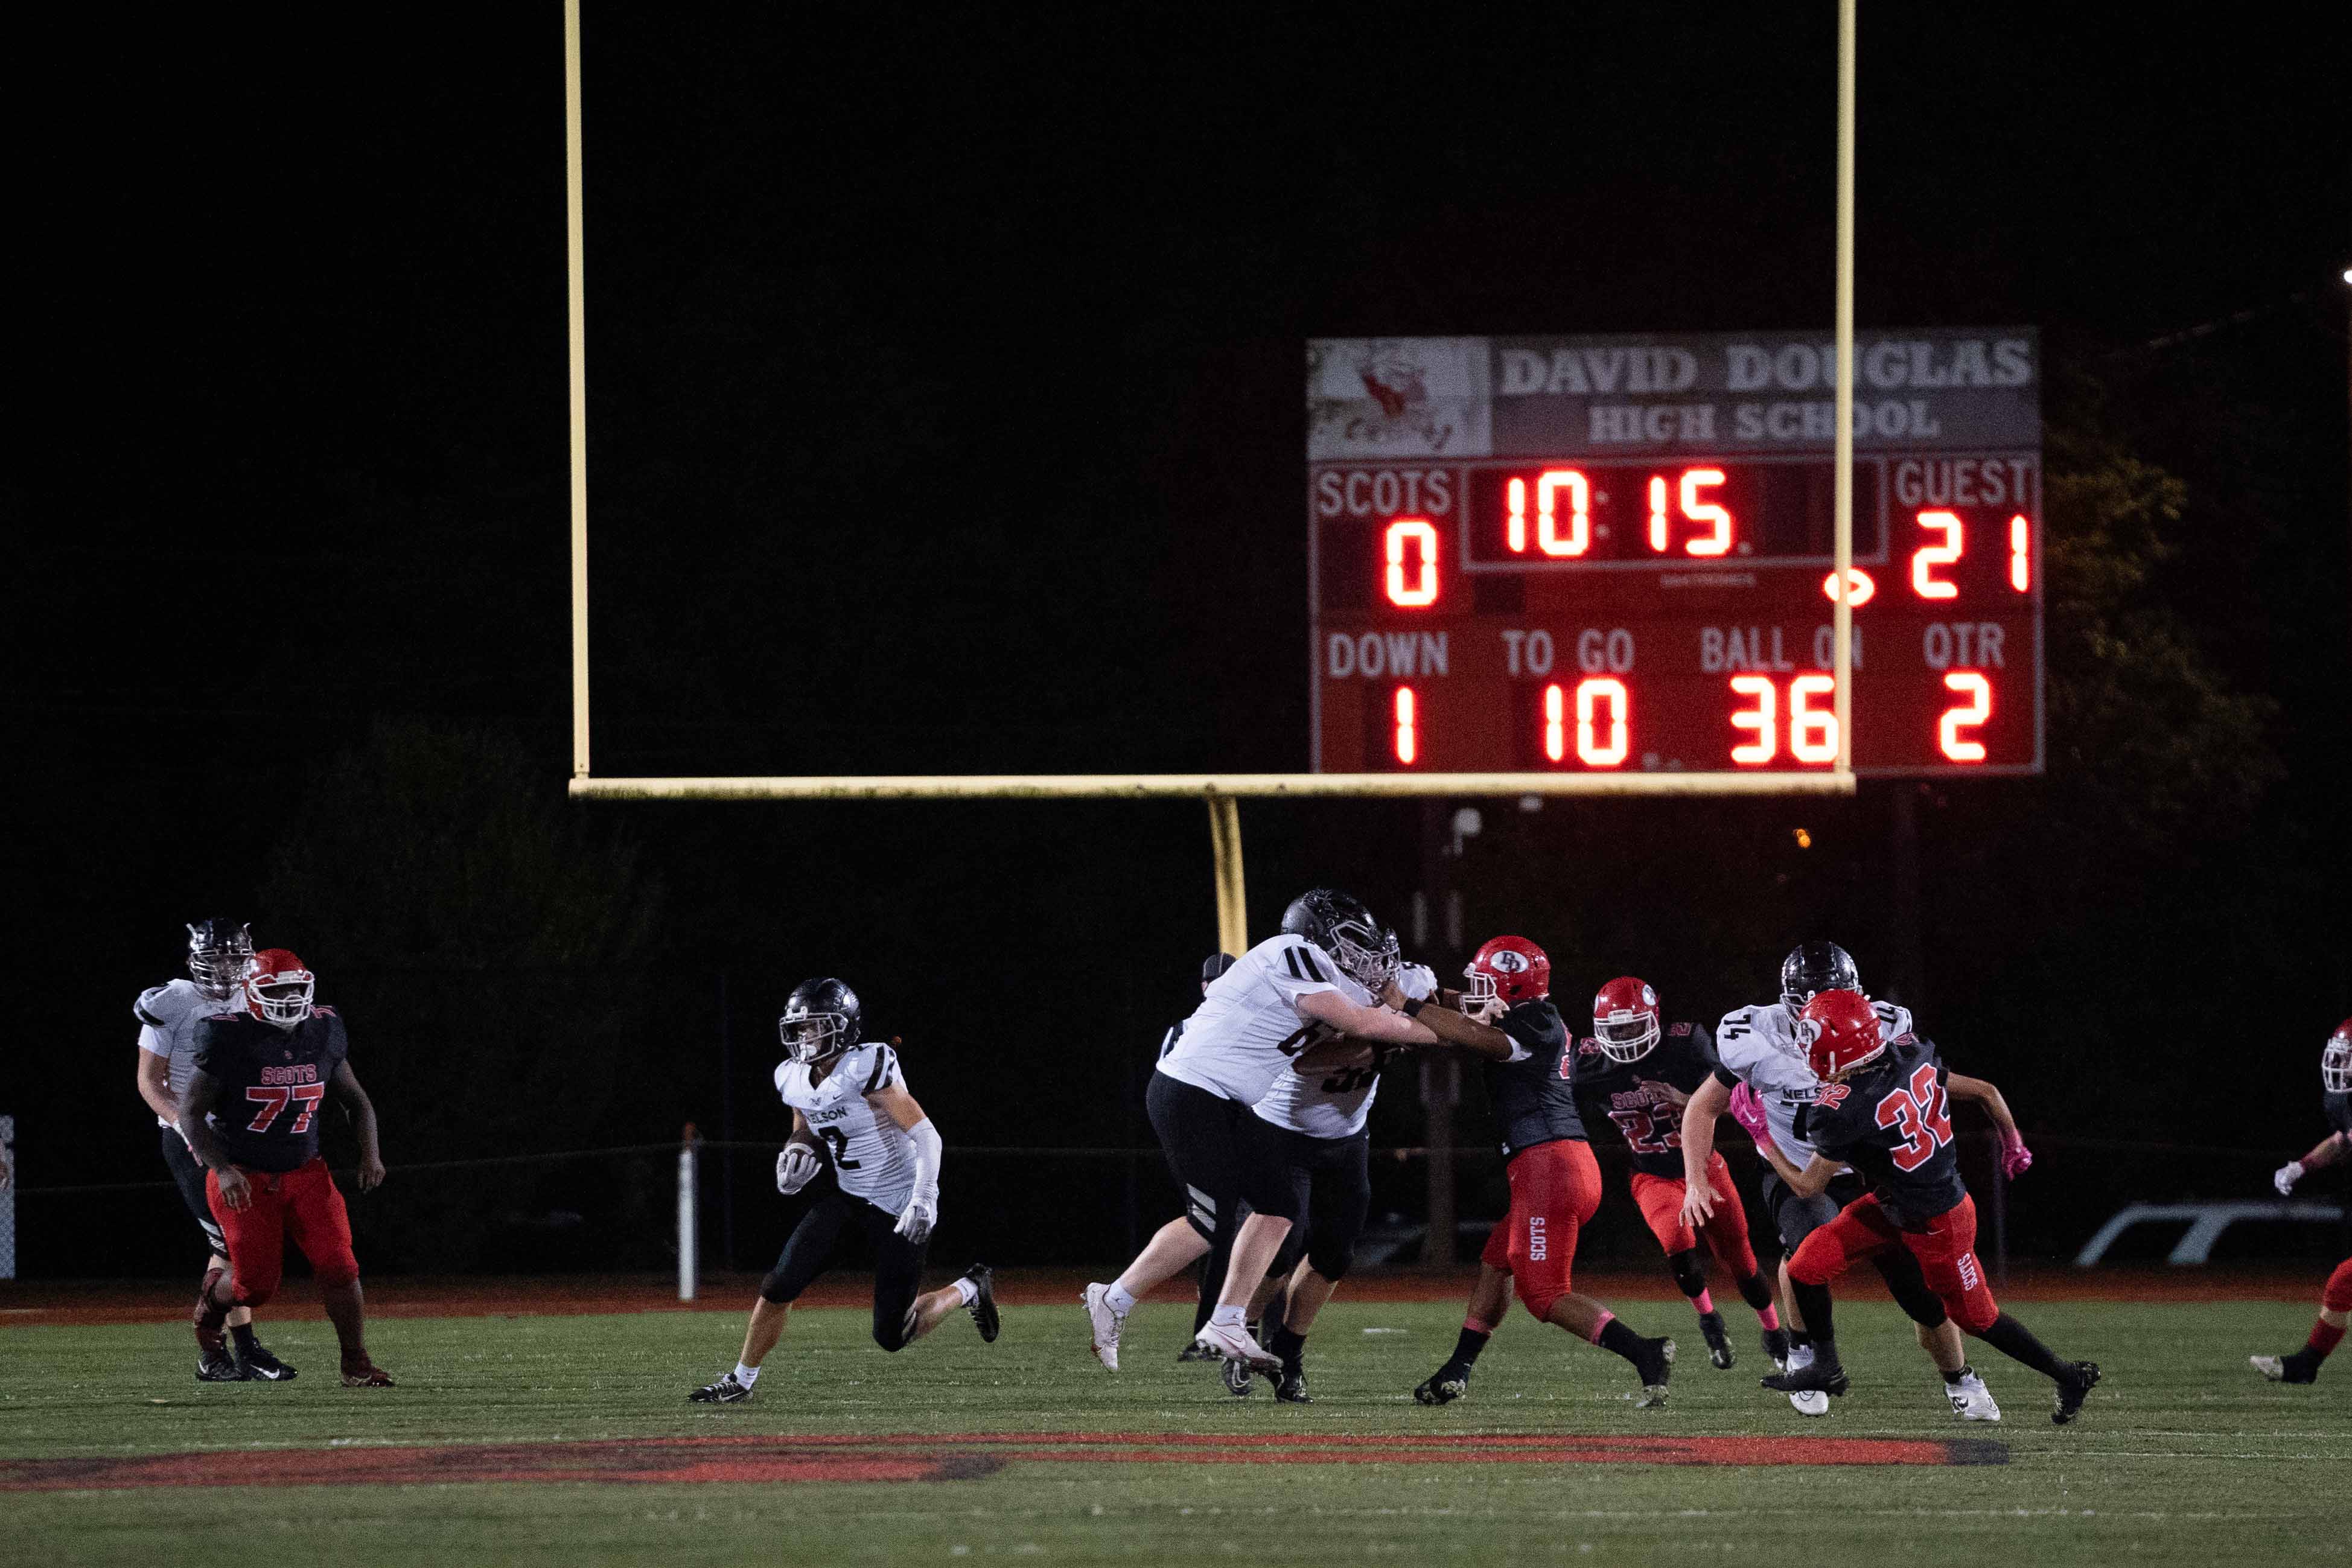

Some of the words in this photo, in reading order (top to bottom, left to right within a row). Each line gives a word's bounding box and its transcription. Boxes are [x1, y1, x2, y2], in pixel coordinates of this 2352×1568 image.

[1501, 346, 1698, 393] DAVID
[1726, 340, 2033, 392] DOUGLAS
[1589, 405, 1715, 441] HIGH
[1735, 400, 1940, 440] SCHOOL
[1319, 470, 1450, 516] SCOTS
[1896, 461, 2033, 506] GUEST
[1386, 521, 1437, 606] 0
[1328, 632, 1448, 677] DOWN
[1502, 630, 1555, 675] TO
[1577, 629, 1634, 674] GO
[1700, 626, 1793, 672] BALL
[1397, 687, 1415, 764] 1
[1546, 679, 1627, 766] 10
[1730, 676, 1839, 763] 36
[1940, 674, 1990, 761] 2
[261, 1063, 316, 1085] SCOTS
[246, 1081, 325, 1133] 77
[1875, 1062, 1954, 1172] 32
[818, 1125, 862, 1170] 2
[1530, 1217, 1546, 1261] SCOTS
[1957, 1252, 1978, 1291] SCOTS
